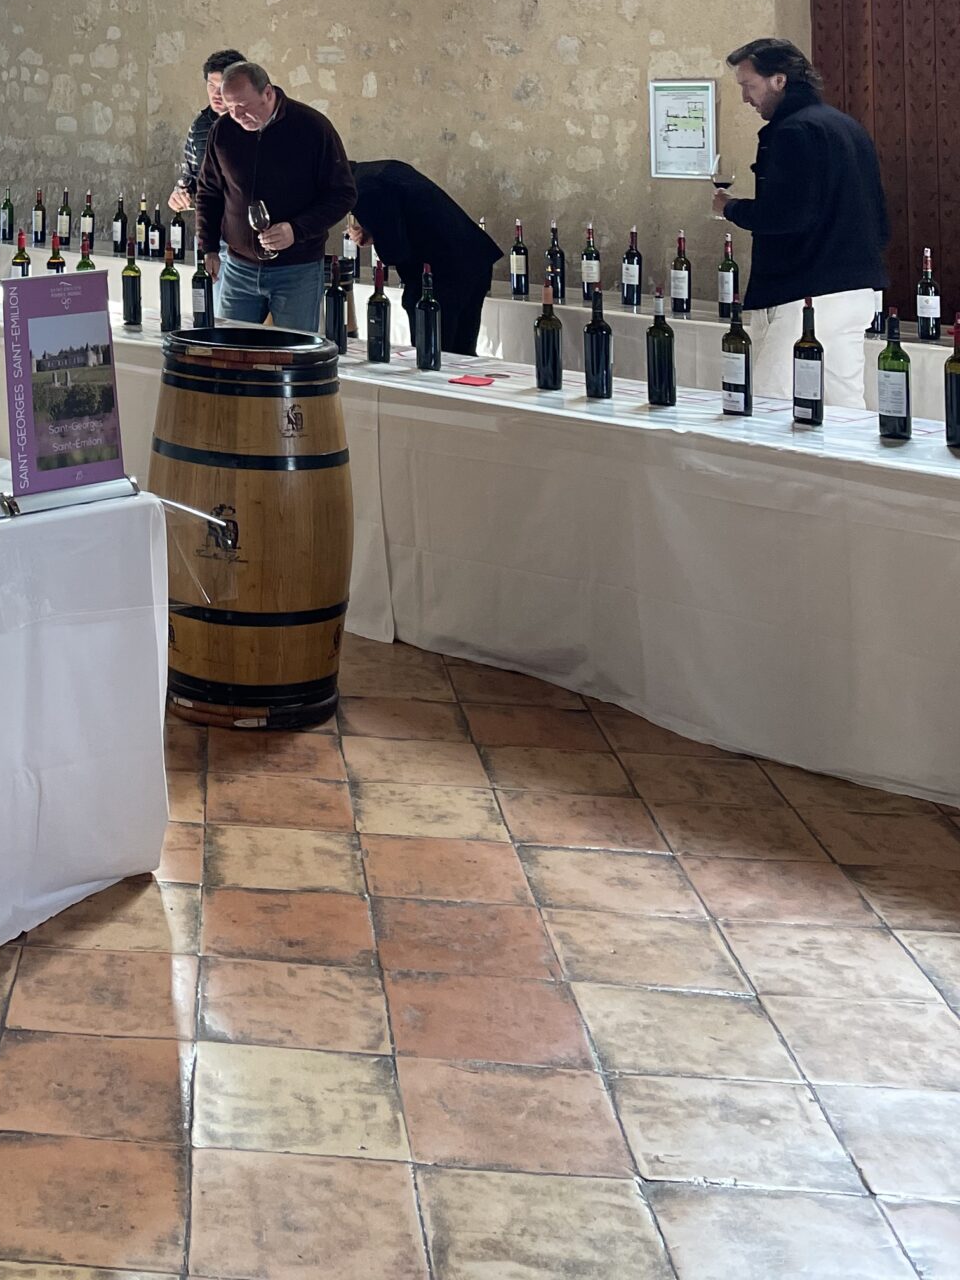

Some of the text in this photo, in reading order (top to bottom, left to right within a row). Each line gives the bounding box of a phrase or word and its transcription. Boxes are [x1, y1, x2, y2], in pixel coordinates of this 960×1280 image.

[9, 286, 29, 489] SAINT-GEORGES SAINT-EMILION
[48, 420, 103, 434] Saint-Georges
